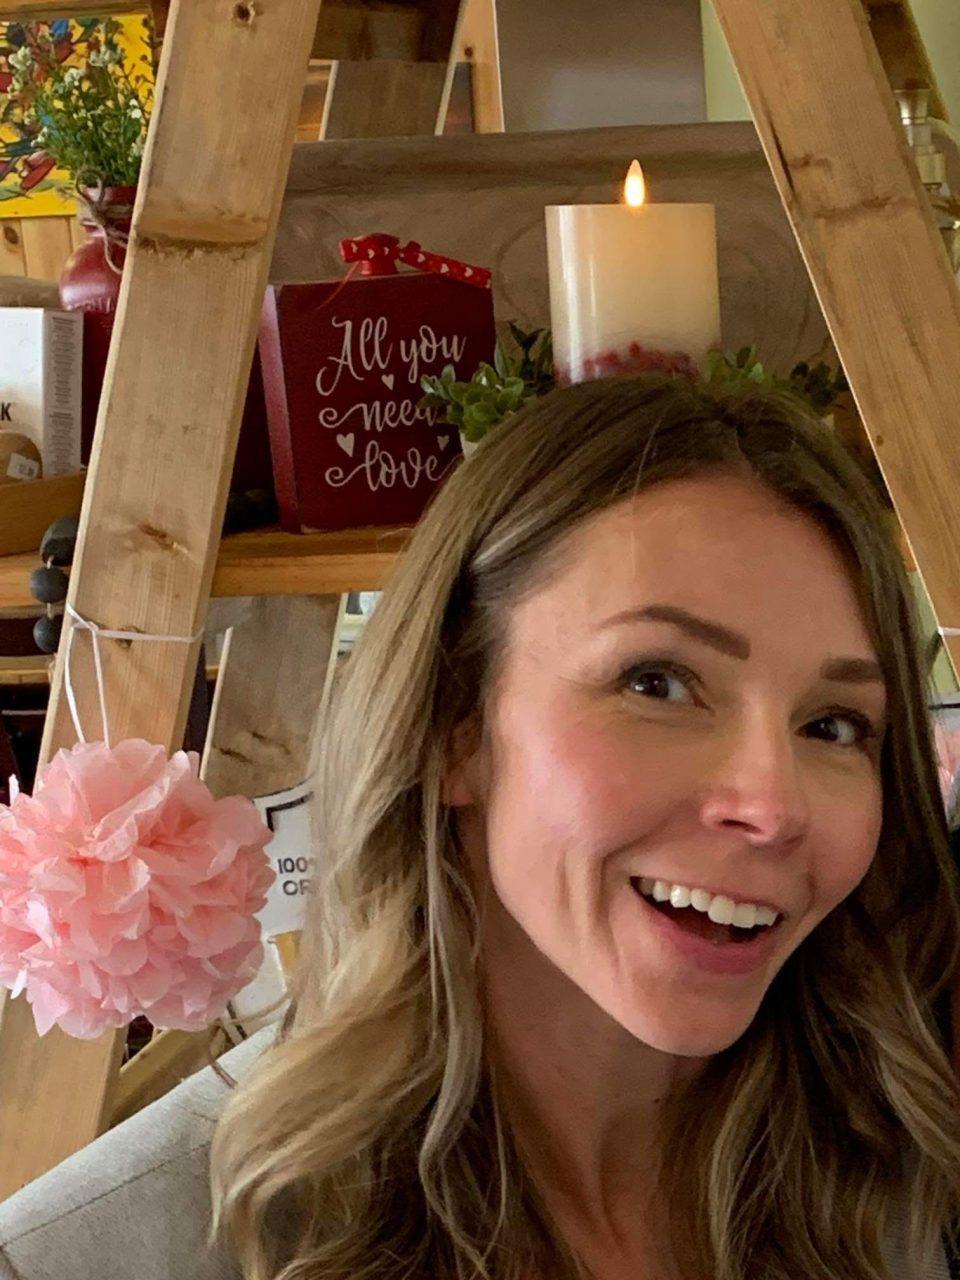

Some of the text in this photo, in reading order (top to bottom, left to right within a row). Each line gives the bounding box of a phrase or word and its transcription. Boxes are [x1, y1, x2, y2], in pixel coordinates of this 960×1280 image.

[316, 316, 467, 396] All you
[325, 440, 465, 491] love
